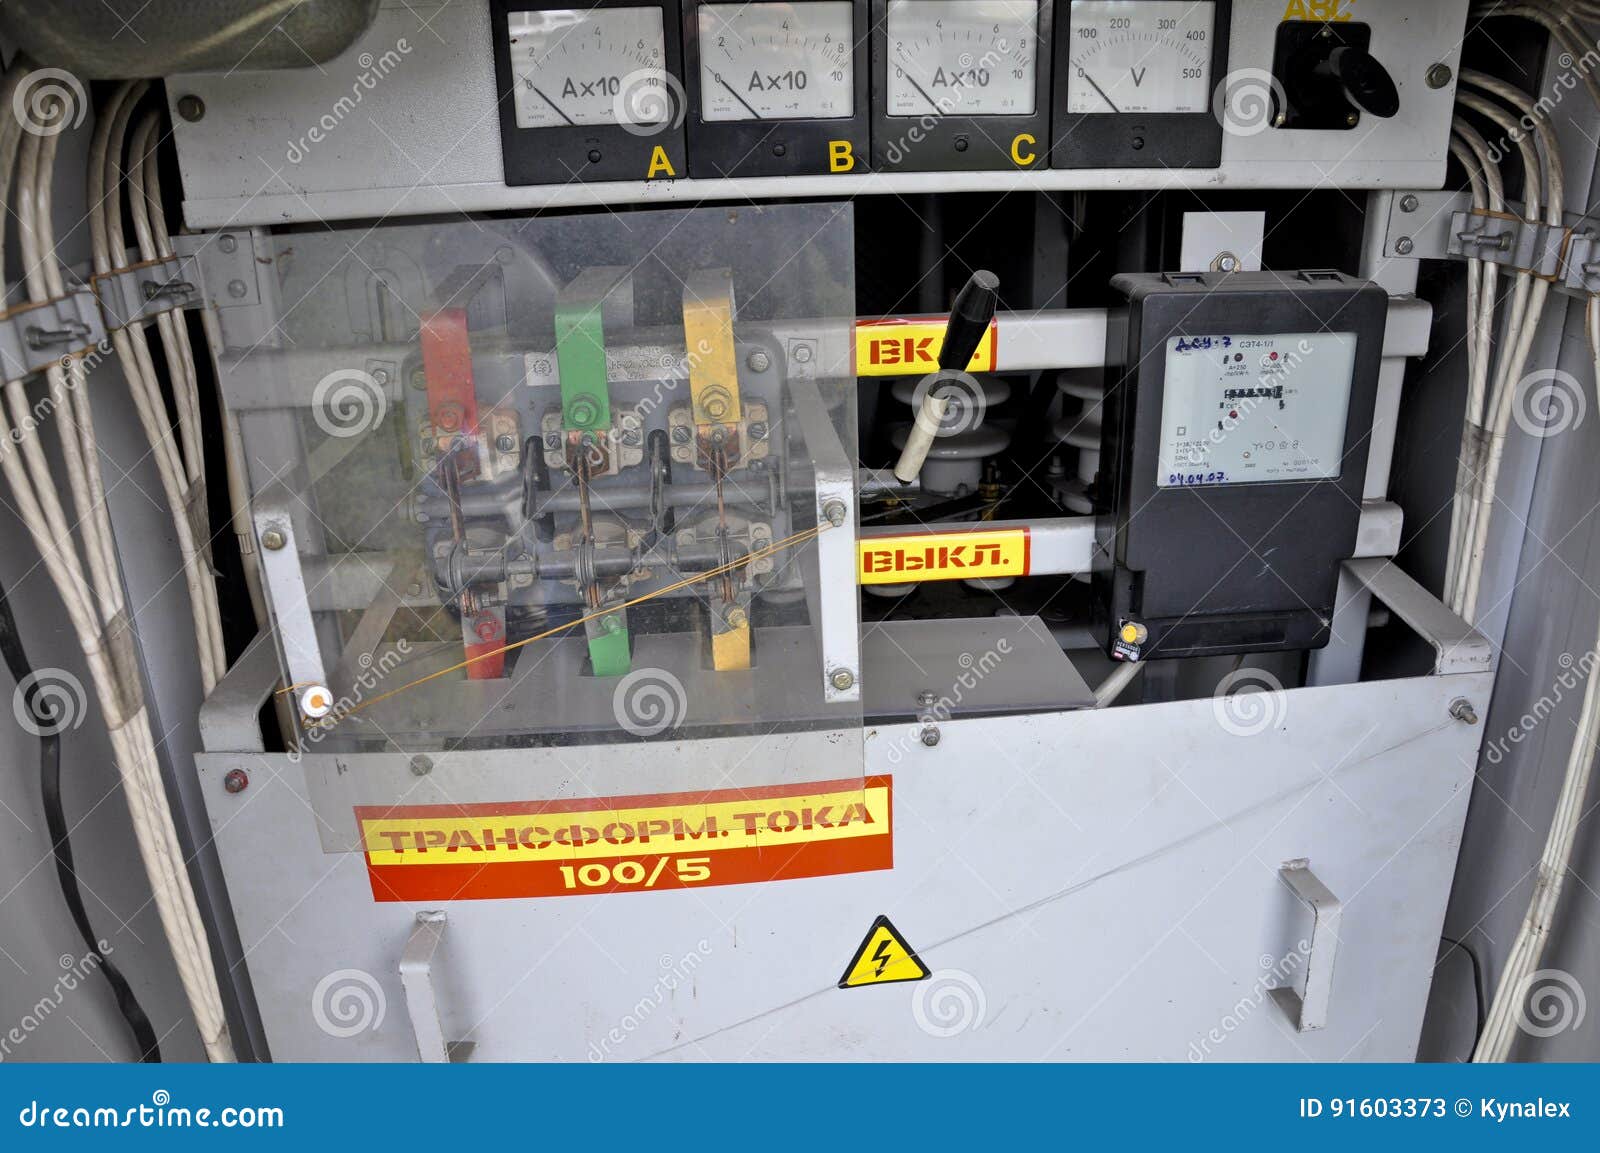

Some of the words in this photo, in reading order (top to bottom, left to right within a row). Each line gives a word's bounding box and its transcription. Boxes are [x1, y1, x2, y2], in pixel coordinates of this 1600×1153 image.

[782, 21, 789, 32] 4
[935, 20, 942, 31] 4
[993, 23, 1000, 34] 6
[1110, 18, 1131, 30] 200
[1158, 18, 1177, 31] 300
[824, 33, 831, 44] 6
[1078, 28, 1097, 40] 100
[1186, 29, 1206, 42] 400
[637, 39, 644, 50] 6
[718, 36, 725, 47] 2
[837, 42, 844, 53] 8
[896, 41, 903, 52] 2
[1019, 38, 1027, 49] 8
[652, 48, 659, 59] 8
[831, 71, 843, 82] 10
[896, 67, 903, 79] 0
[1012, 68, 1023, 80] 10
[1078, 67, 1085, 79] 0
[1130, 66, 1146, 88] V
[1182, 67, 1202, 79] 500
[646, 76, 658, 87] 10
[1011, 133, 1036, 165] C
[647, 146, 676, 179] A
[828, 140, 855, 173] B
[869, 337, 981, 366] ВК.
[863, 543, 1010, 574] ВЫКЛ.
[559, 856, 711, 889] 100/5
